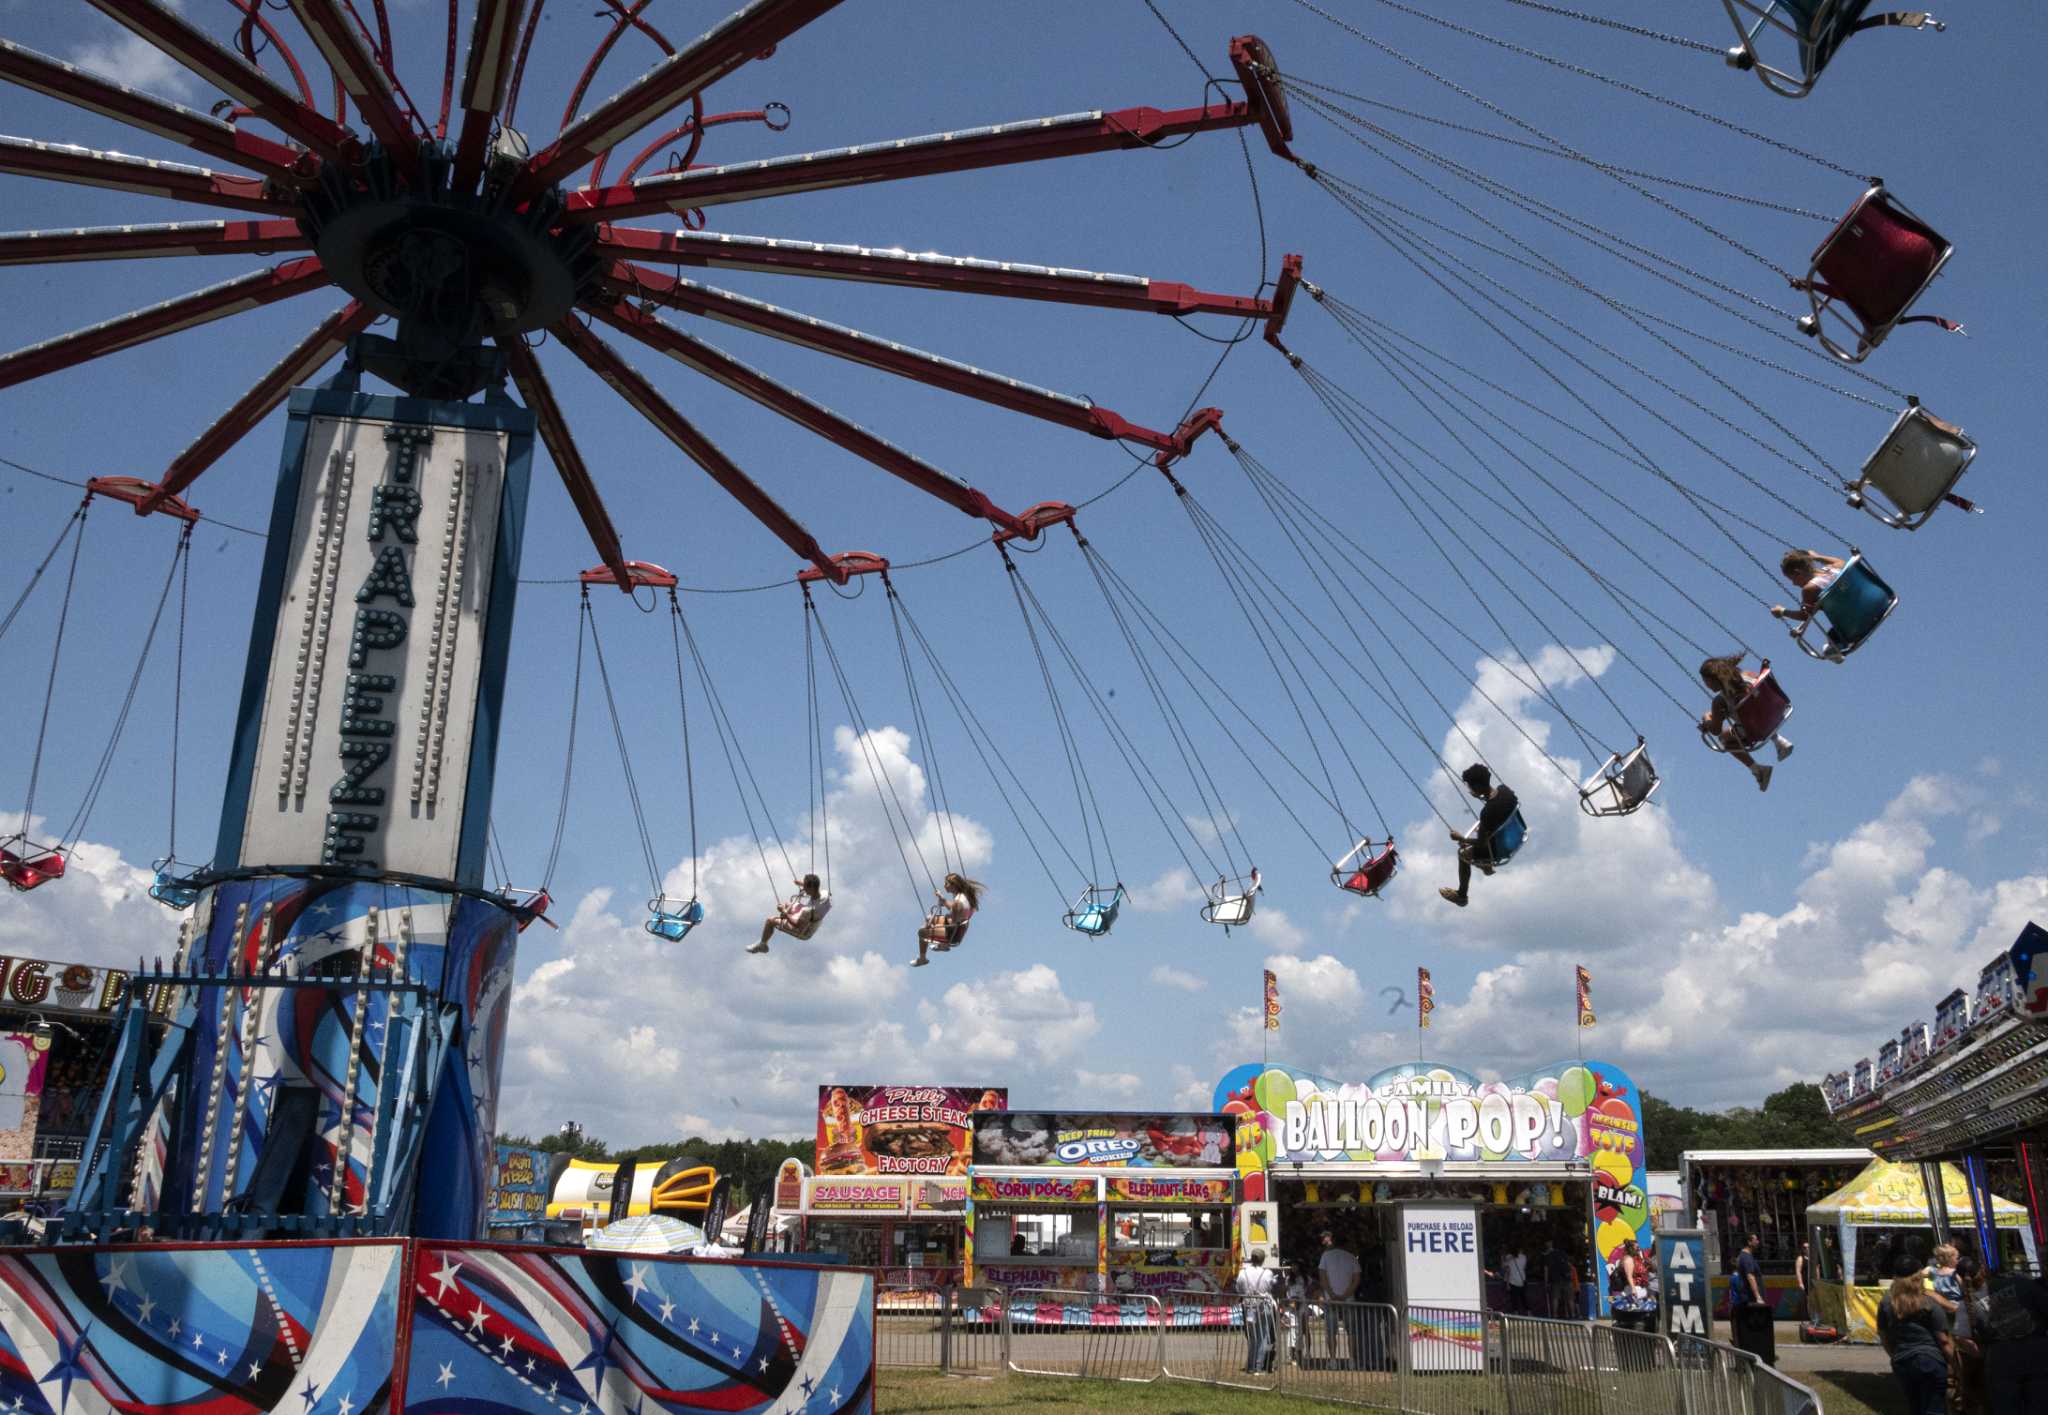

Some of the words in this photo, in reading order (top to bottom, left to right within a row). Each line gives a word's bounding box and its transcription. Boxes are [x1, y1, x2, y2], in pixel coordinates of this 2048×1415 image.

[320, 424, 434, 868] TRAPEZE
[1380, 1080, 1474, 1097] FAMILY
[886, 1088, 947, 1107] Philly
[860, 1105, 919, 1126] CHEESE
[921, 1106, 968, 1128] STEAK
[1286, 1099, 1431, 1151] BALLOON
[1447, 1094, 1564, 1153] POP!
[1057, 1130, 1084, 1142] DEEP
[1087, 1128, 1116, 1138] FRIED
[1059, 1139, 1139, 1160] OREO
[877, 1155, 950, 1173] FACTORY
[815, 1186, 900, 1200] SAUSAGE
[919, 1187, 966, 1200] FNCH
[996, 1183, 1031, 1197] CORN
[1035, 1183, 1073, 1197] DOGS
[1128, 1182, 1179, 1197] ELEPHANT
[1182, 1183, 1210, 1198] EARS
[1598, 1186, 1643, 1209] BLAM!
[1408, 1223, 1441, 1231] PURCHASE
[1442, 1223, 1447, 1231] &
[1449, 1223, 1473, 1231] RELOAD
[1408, 1232, 1474, 1253] HERE
[988, 1268, 1058, 1283] ELEPHANT
[1135, 1271, 1186, 1286] FUNNEL
[1670, 1241, 1705, 1333] ATM
